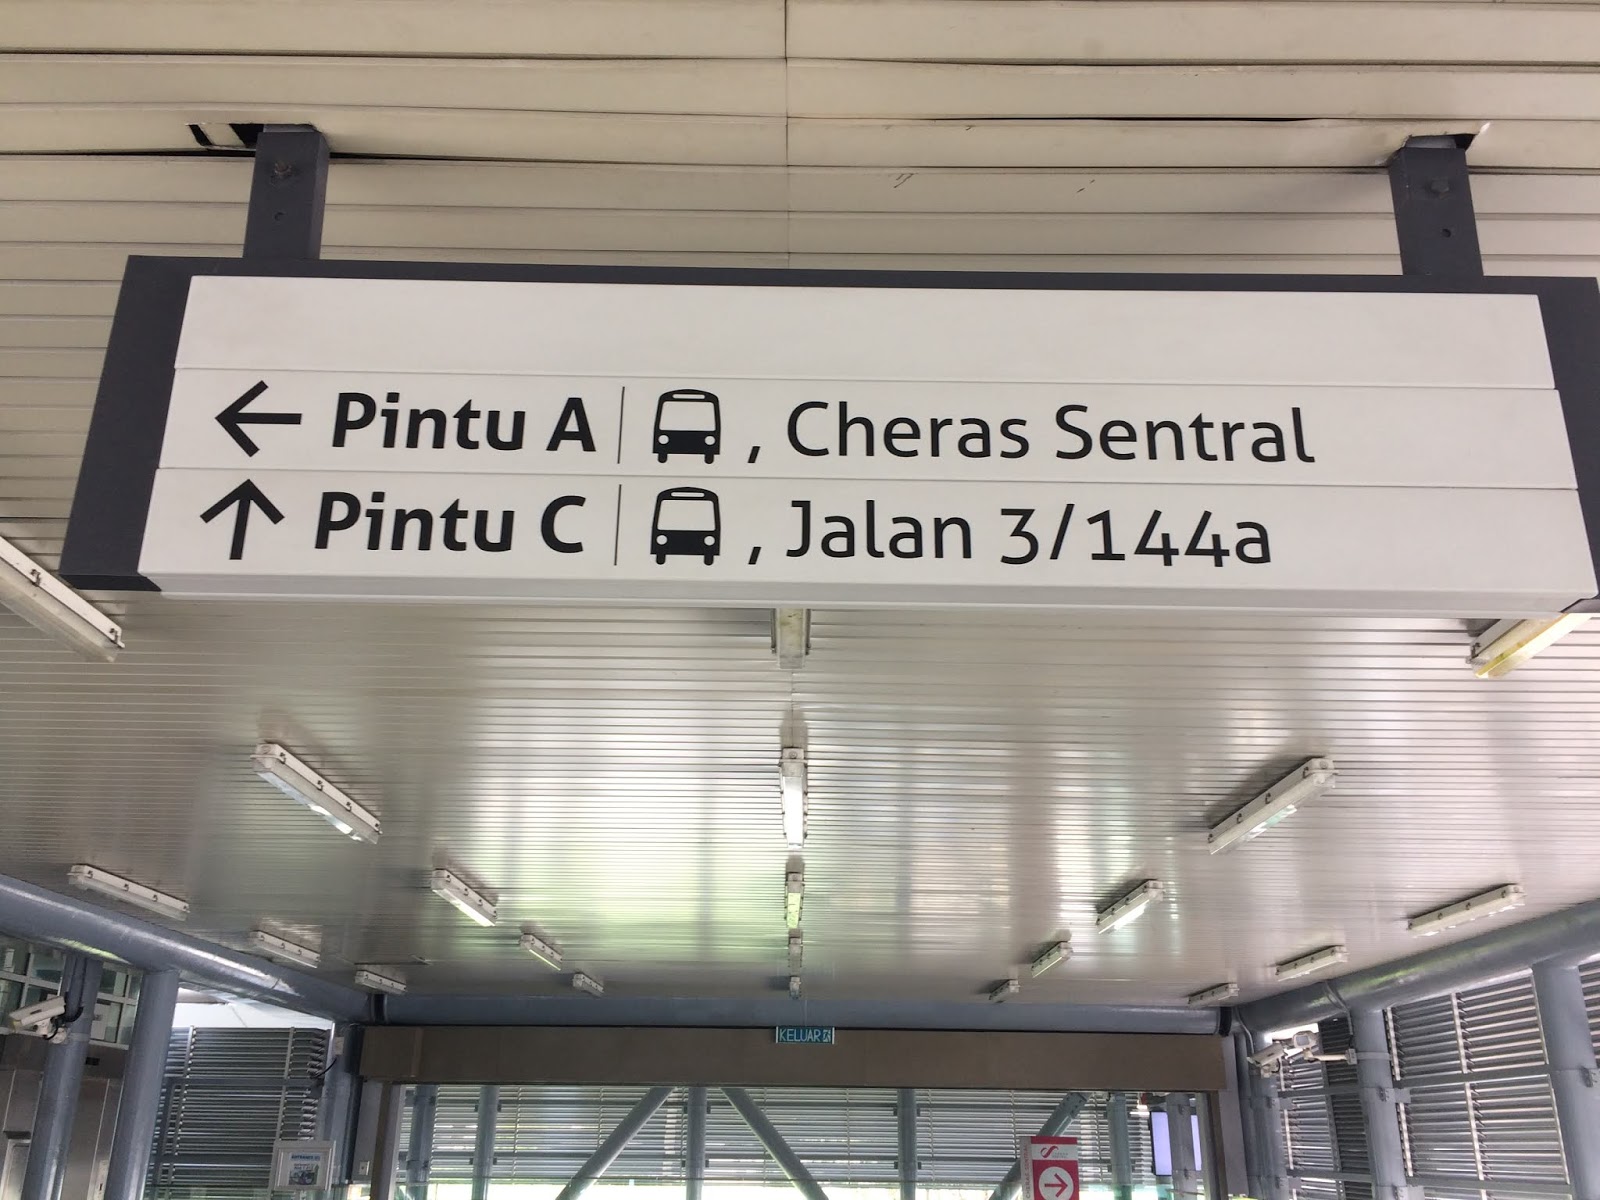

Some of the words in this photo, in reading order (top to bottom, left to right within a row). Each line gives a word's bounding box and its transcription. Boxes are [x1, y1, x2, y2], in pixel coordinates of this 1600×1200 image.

[332, 391, 526, 451] Pintu
[545, 397, 597, 453] A
[787, 400, 1030, 460] Cheras
[1055, 404, 1316, 463] Sentral
[314, 491, 515, 553] Pintu
[540, 495, 587, 554] C
[786, 499, 972, 560] Jalan
[1000, 503, 1271, 568] 3/144a
[779, 1028, 821, 1042] KELUAR
